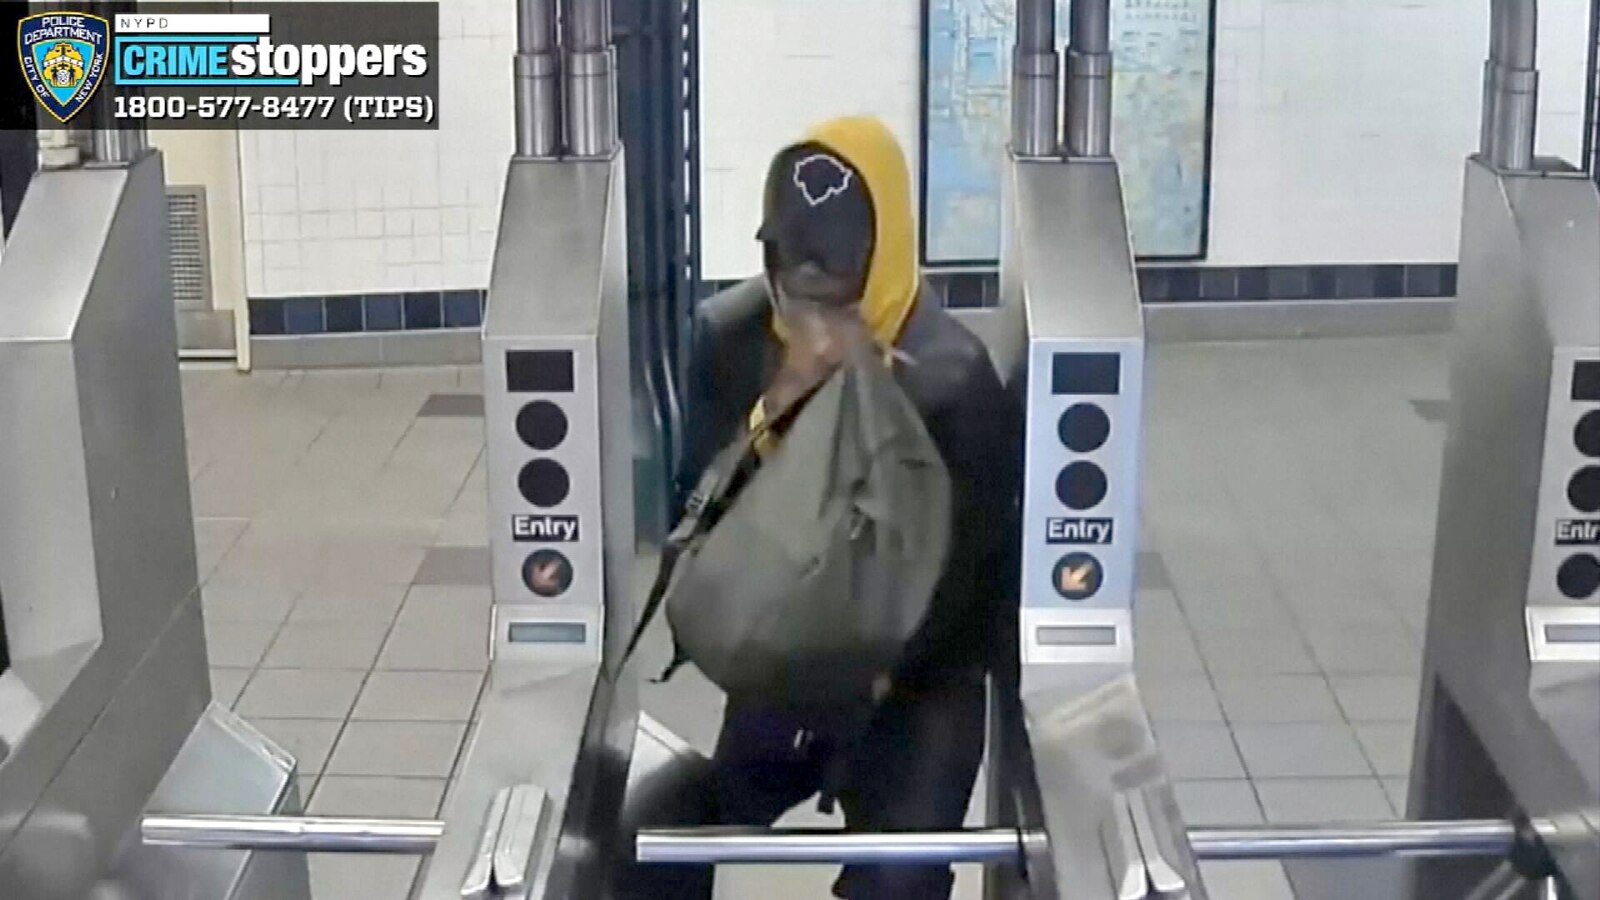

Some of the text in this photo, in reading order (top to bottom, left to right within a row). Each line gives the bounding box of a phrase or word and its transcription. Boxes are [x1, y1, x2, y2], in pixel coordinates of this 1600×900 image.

[514, 516, 576, 540] Entry
[1048, 519, 1110, 543] Entry
[1557, 520, 1600, 540] Entr
